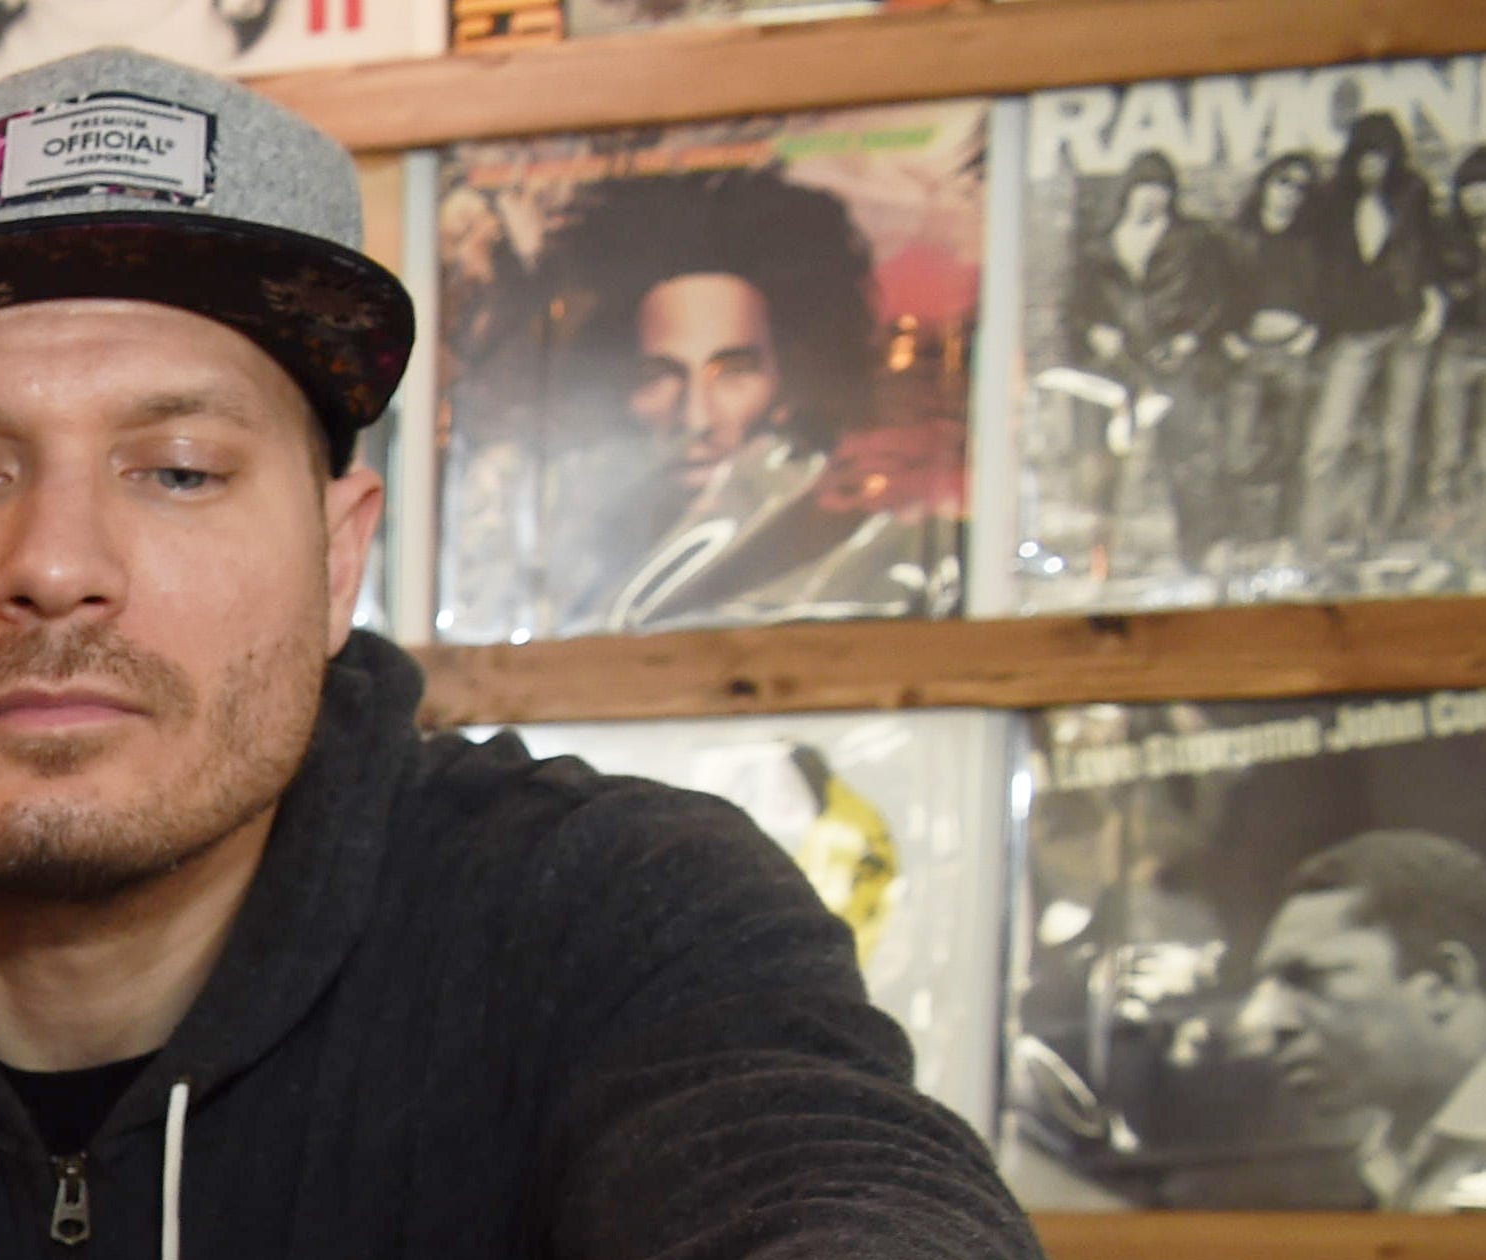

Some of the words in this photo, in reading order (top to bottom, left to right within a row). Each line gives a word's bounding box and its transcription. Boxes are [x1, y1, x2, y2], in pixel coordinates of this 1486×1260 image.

[70, 115, 147, 129] PREMIUM
[1029, 54, 1486, 179] RAMON
[77, 153, 137, 165] EXPORTS
